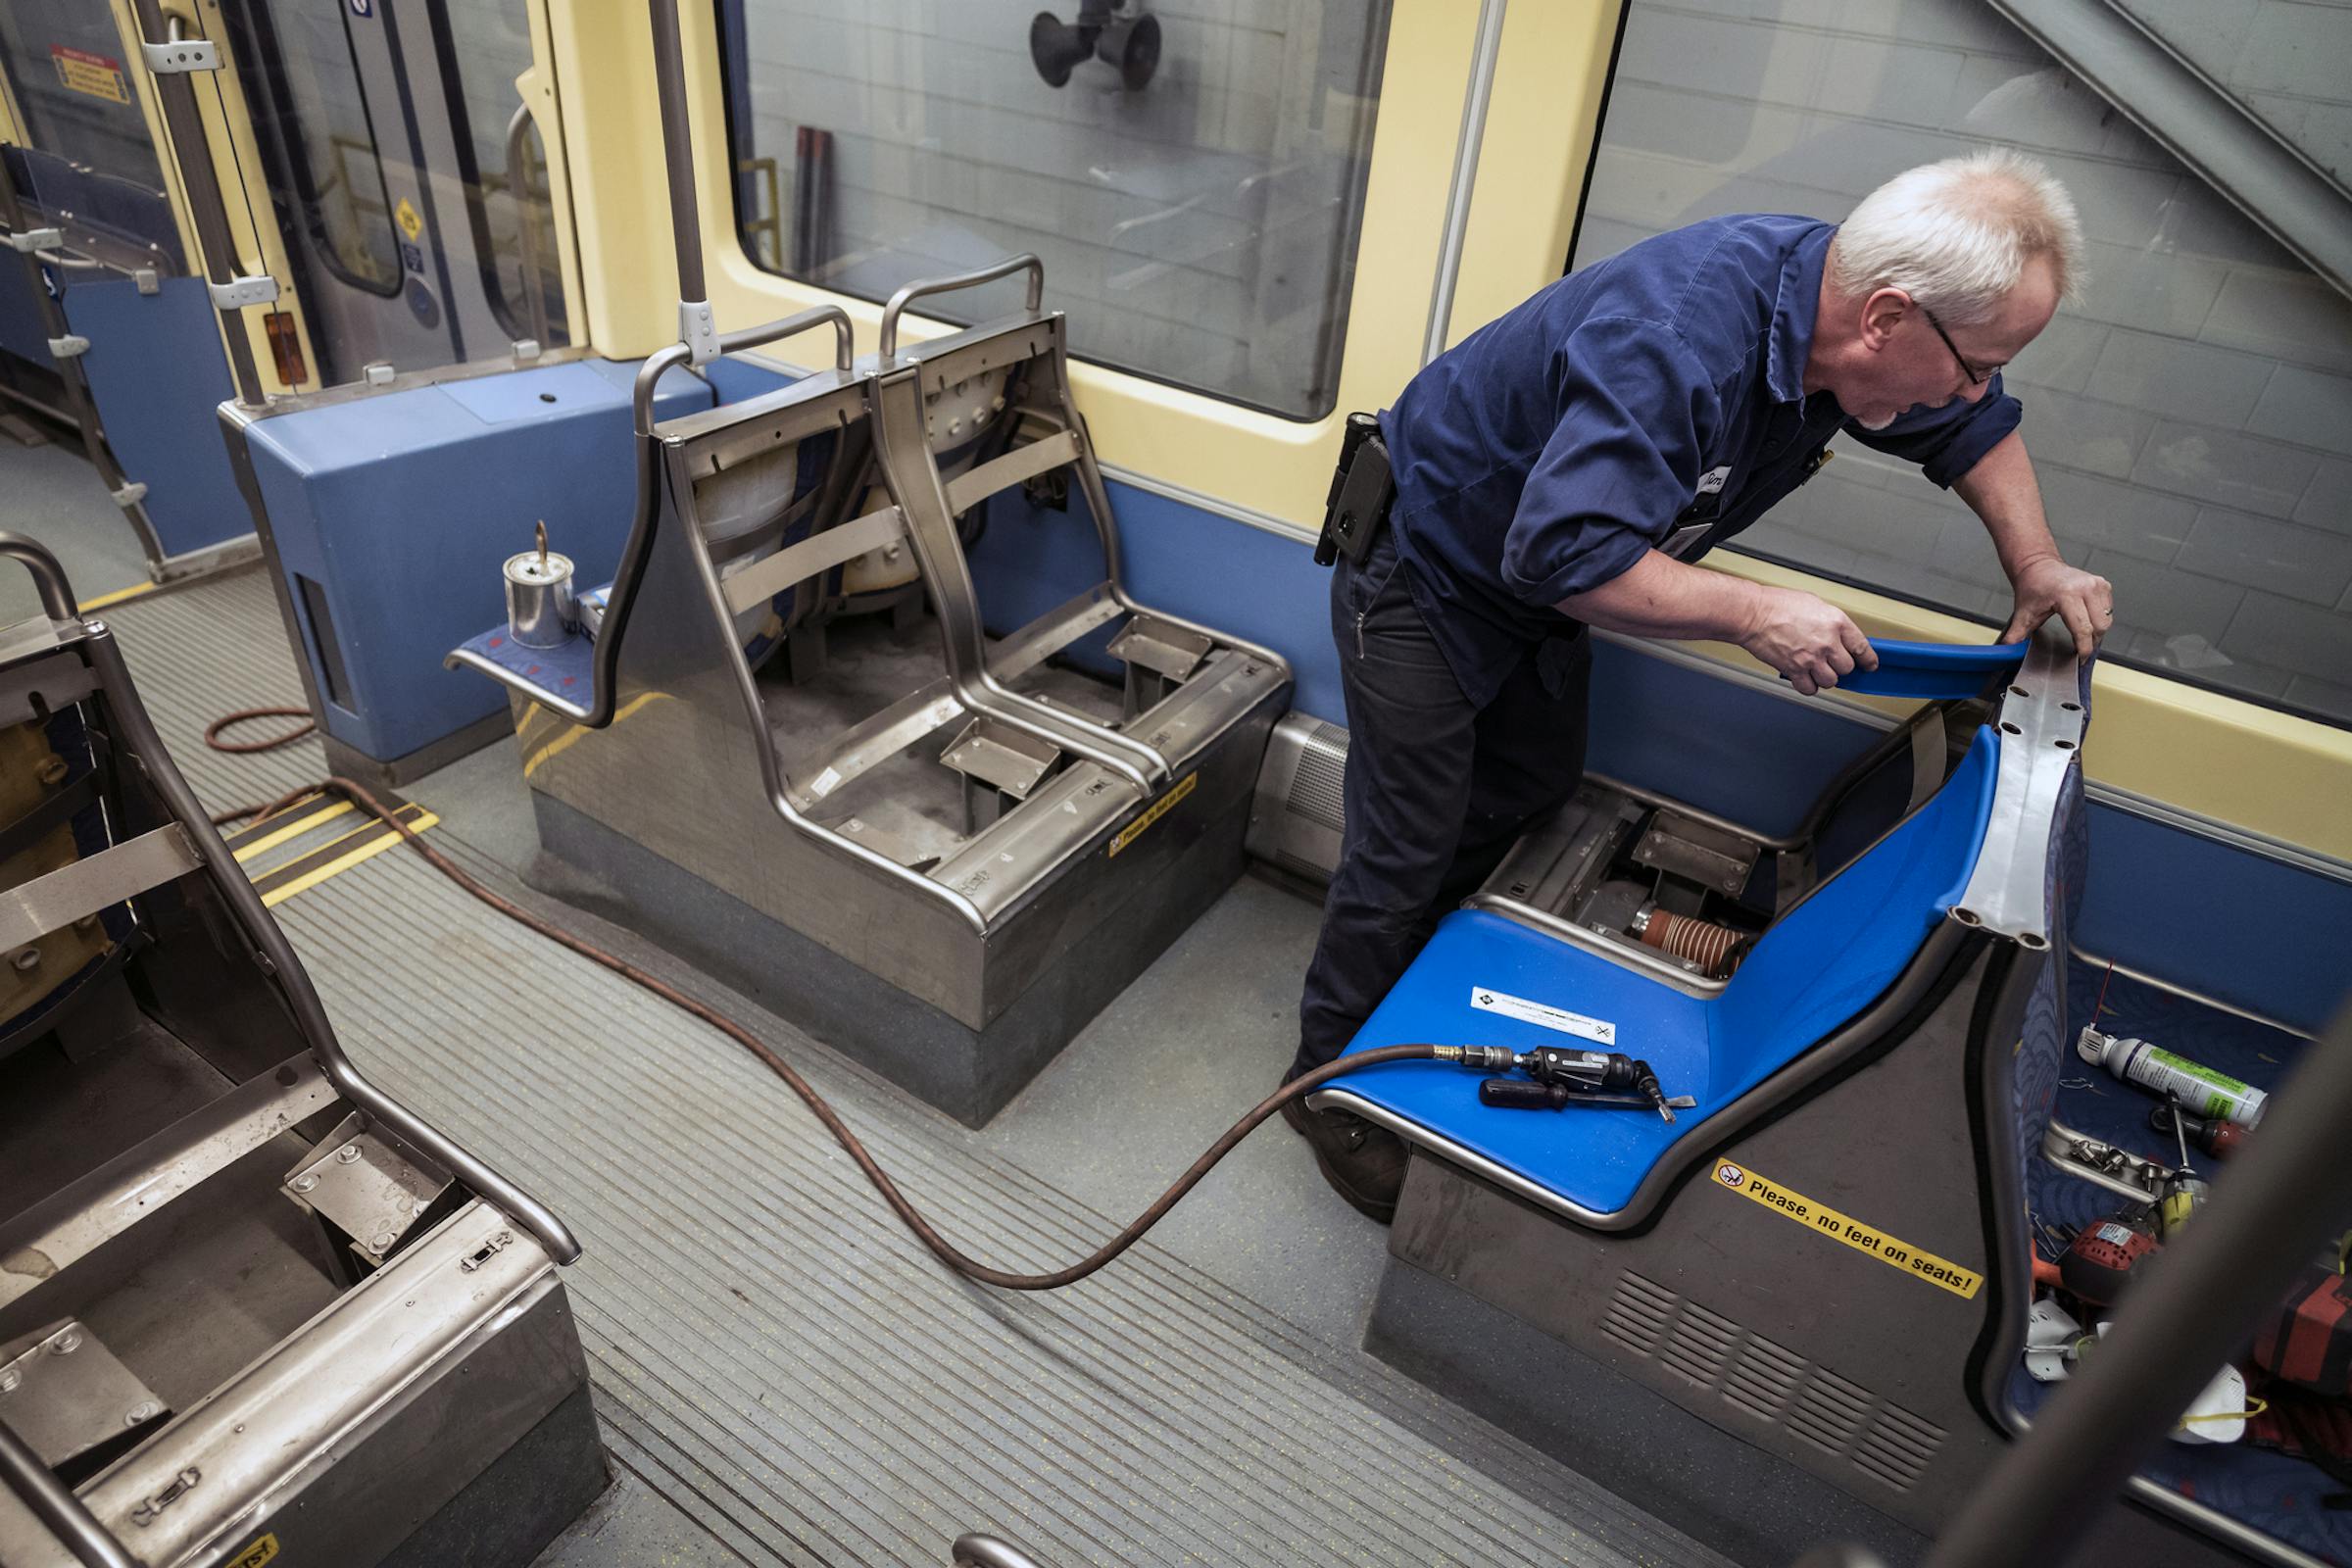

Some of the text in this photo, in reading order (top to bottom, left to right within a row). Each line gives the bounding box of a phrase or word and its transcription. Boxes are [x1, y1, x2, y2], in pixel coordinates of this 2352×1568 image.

[1749, 1180, 1973, 1292] Please, no feet on seats!
